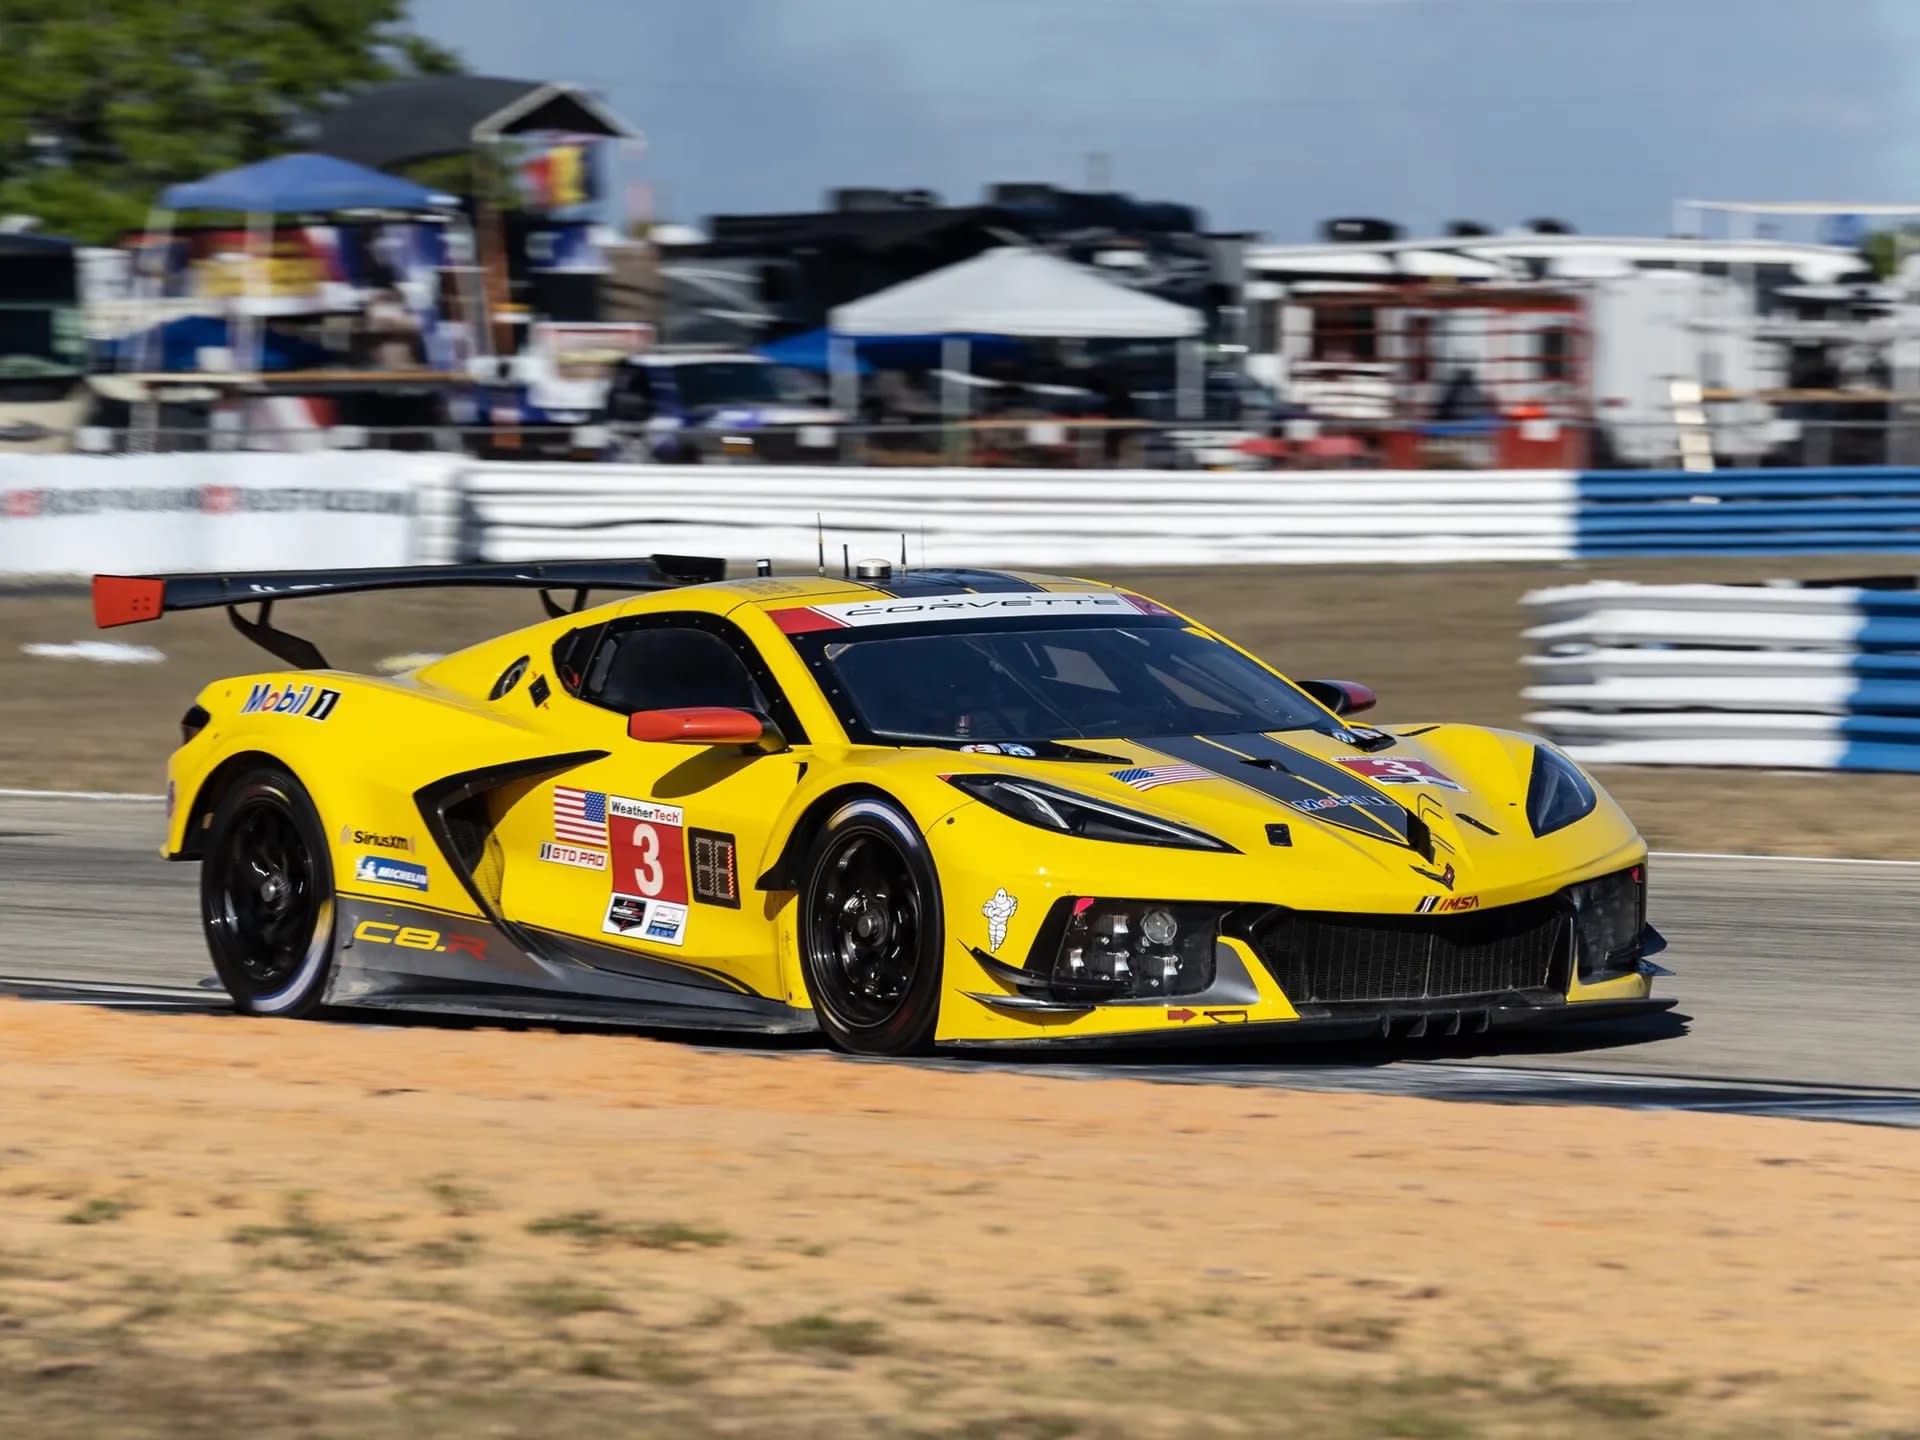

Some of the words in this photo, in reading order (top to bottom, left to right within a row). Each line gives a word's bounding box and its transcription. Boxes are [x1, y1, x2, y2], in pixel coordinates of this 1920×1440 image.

[846, 599, 1120, 616] CORVETTE
[240, 684, 314, 713] Mobil
[308, 690, 337, 719] 1
[1372, 760, 1421, 775] 3
[612, 801, 679, 823] WeatherTech
[1291, 796, 1369, 811] Mobil
[552, 847, 577, 862] GTD
[579, 852, 605, 867] PRO
[633, 823, 664, 896] 3
[377, 866, 427, 884] MICHELIN
[1439, 896, 1480, 911] IMSA
[354, 920, 486, 960] C8.R
